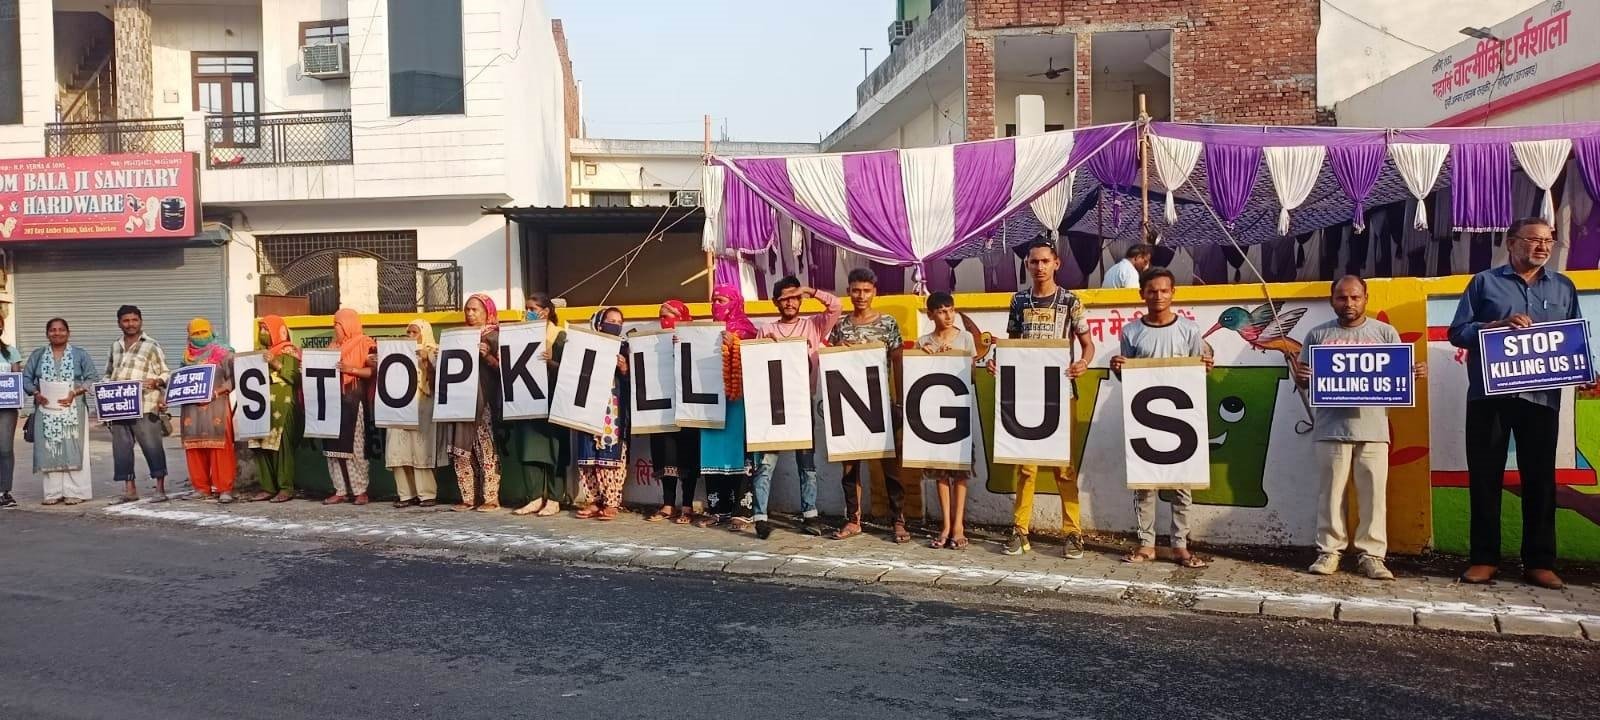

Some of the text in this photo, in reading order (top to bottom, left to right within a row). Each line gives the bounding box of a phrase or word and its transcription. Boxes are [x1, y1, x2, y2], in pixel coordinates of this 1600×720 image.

[1505, 10, 1571, 66] धर्मशाला
[23, 172, 69, 191] BALA
[73, 170, 90, 193] JI
[94, 168, 180, 190] SANITARY
[9, 194, 125, 216] & HARDWARE
[1503, 330, 1565, 357] STOP
[1331, 352, 1390, 373] STOP
[1490, 358, 1546, 379] KILLING
[1549, 355, 1570, 373] US
[1317, 376, 1369, 392] KILLING
[1373, 376, 1391, 392] US
